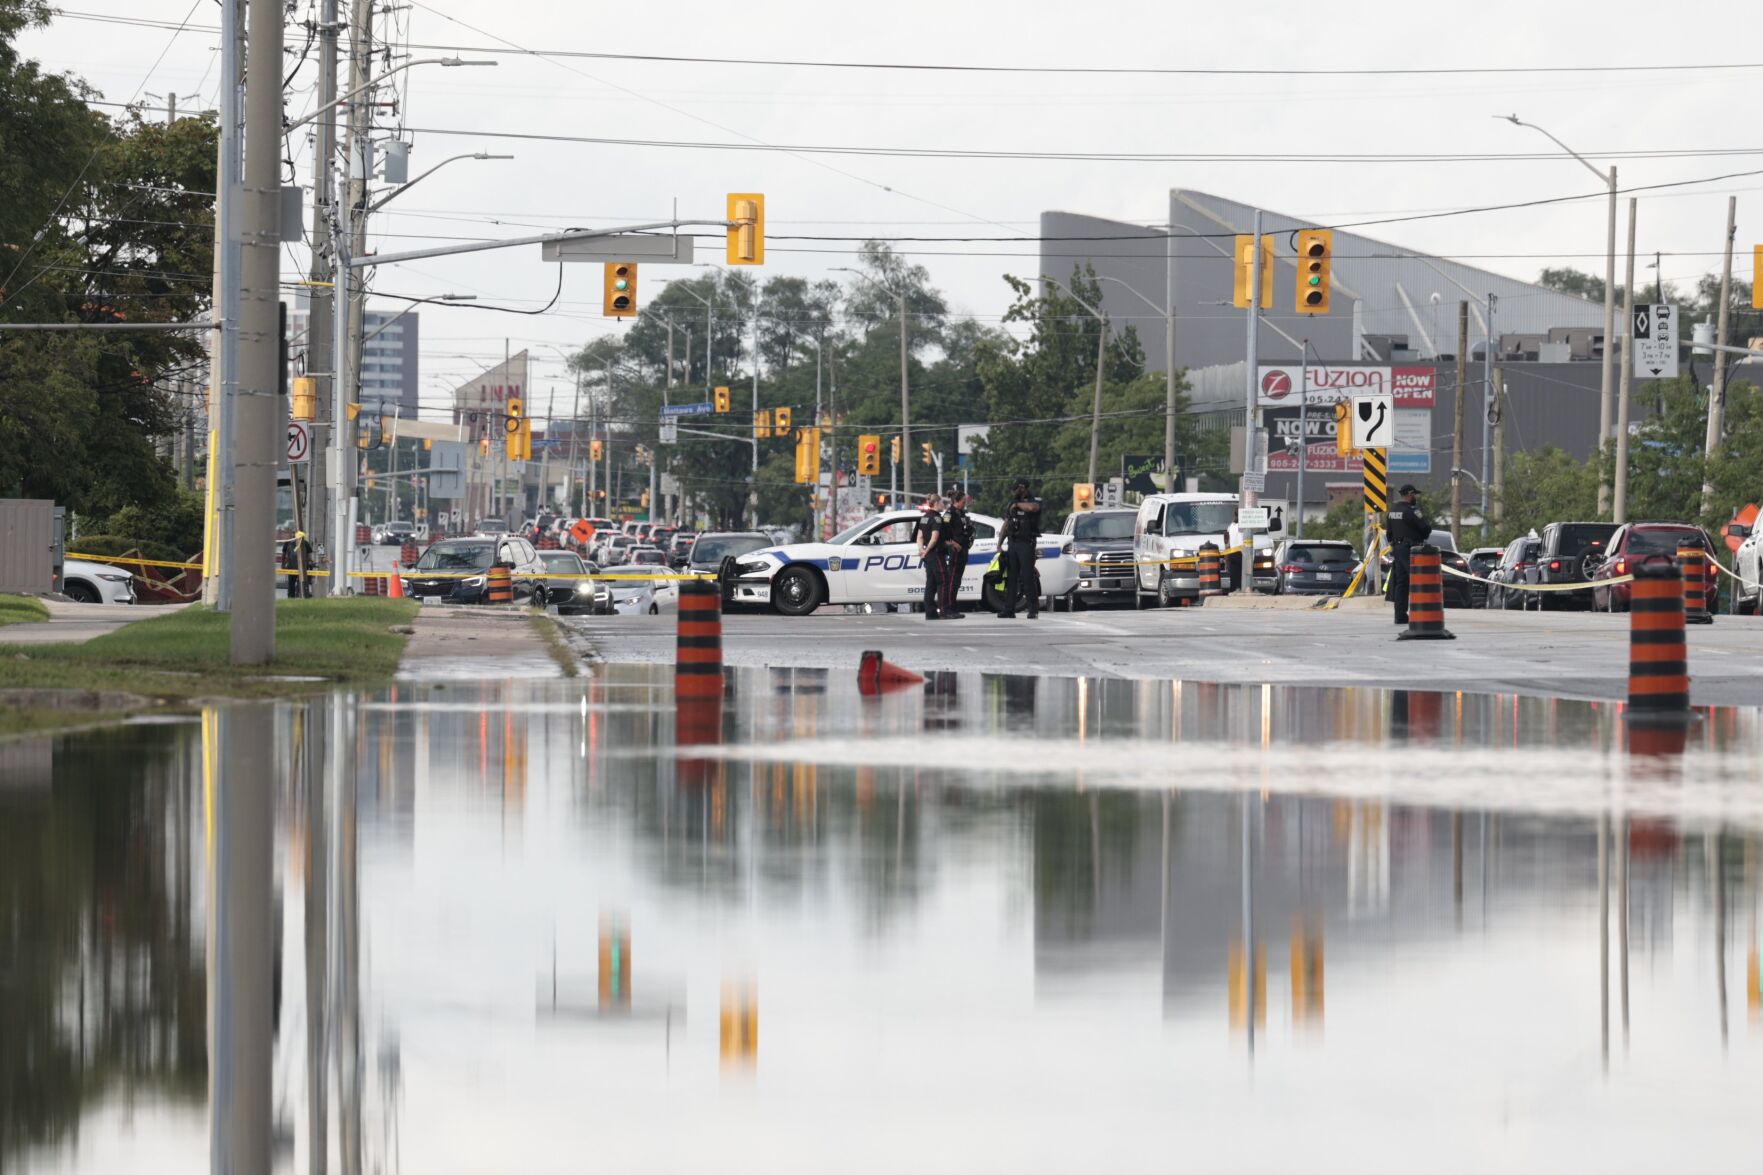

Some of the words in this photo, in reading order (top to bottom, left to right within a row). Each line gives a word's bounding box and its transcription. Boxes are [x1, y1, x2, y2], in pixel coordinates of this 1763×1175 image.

[1396, 375, 1431, 386] NOW
[481, 384, 520, 401] INN
[1392, 386, 1433, 399] OPEN
[1276, 421, 1320, 435] NOW
[1270, 460, 1337, 468] 905-27-3333
